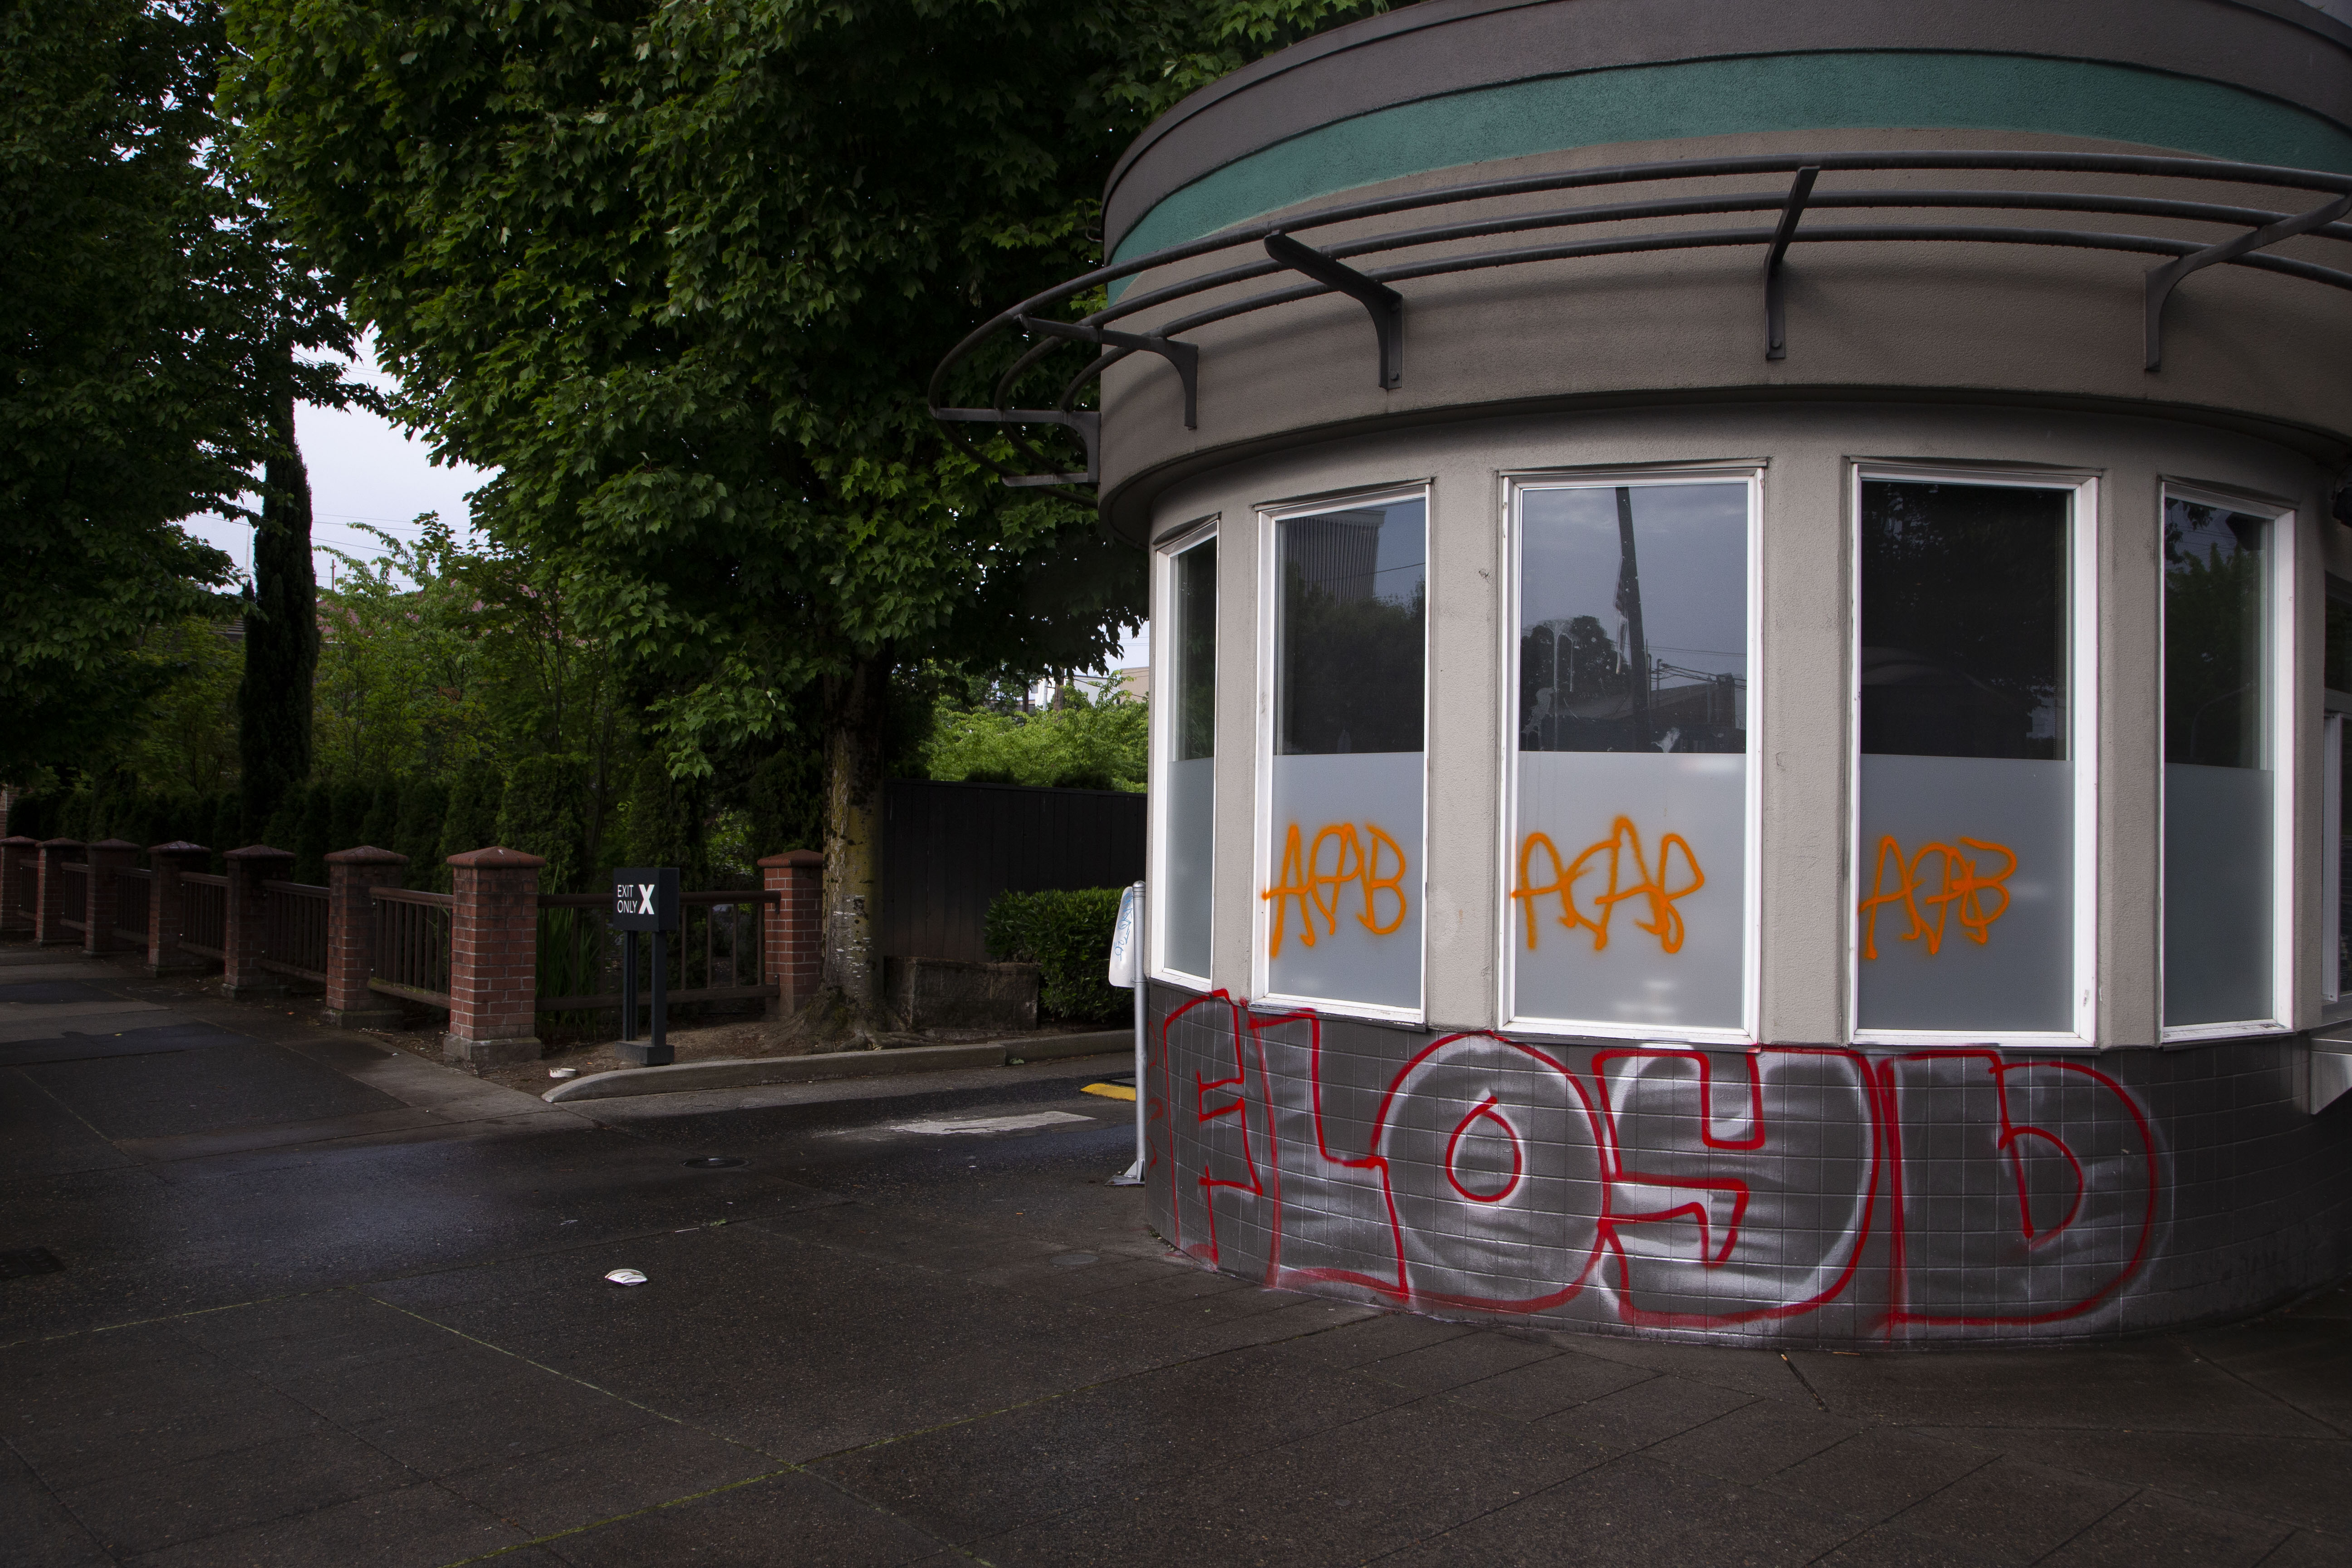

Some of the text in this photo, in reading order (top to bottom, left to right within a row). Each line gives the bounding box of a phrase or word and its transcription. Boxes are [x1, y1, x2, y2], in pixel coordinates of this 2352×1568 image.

[617, 885, 634, 897] EXIT
[617, 900, 637, 913] ONLY
[1261, 823, 1406, 957] ACAB
[1510, 816, 1705, 954] ACAB
[1858, 835, 2018, 960] ACAB
[1162, 988, 2160, 1344] FLOYD
